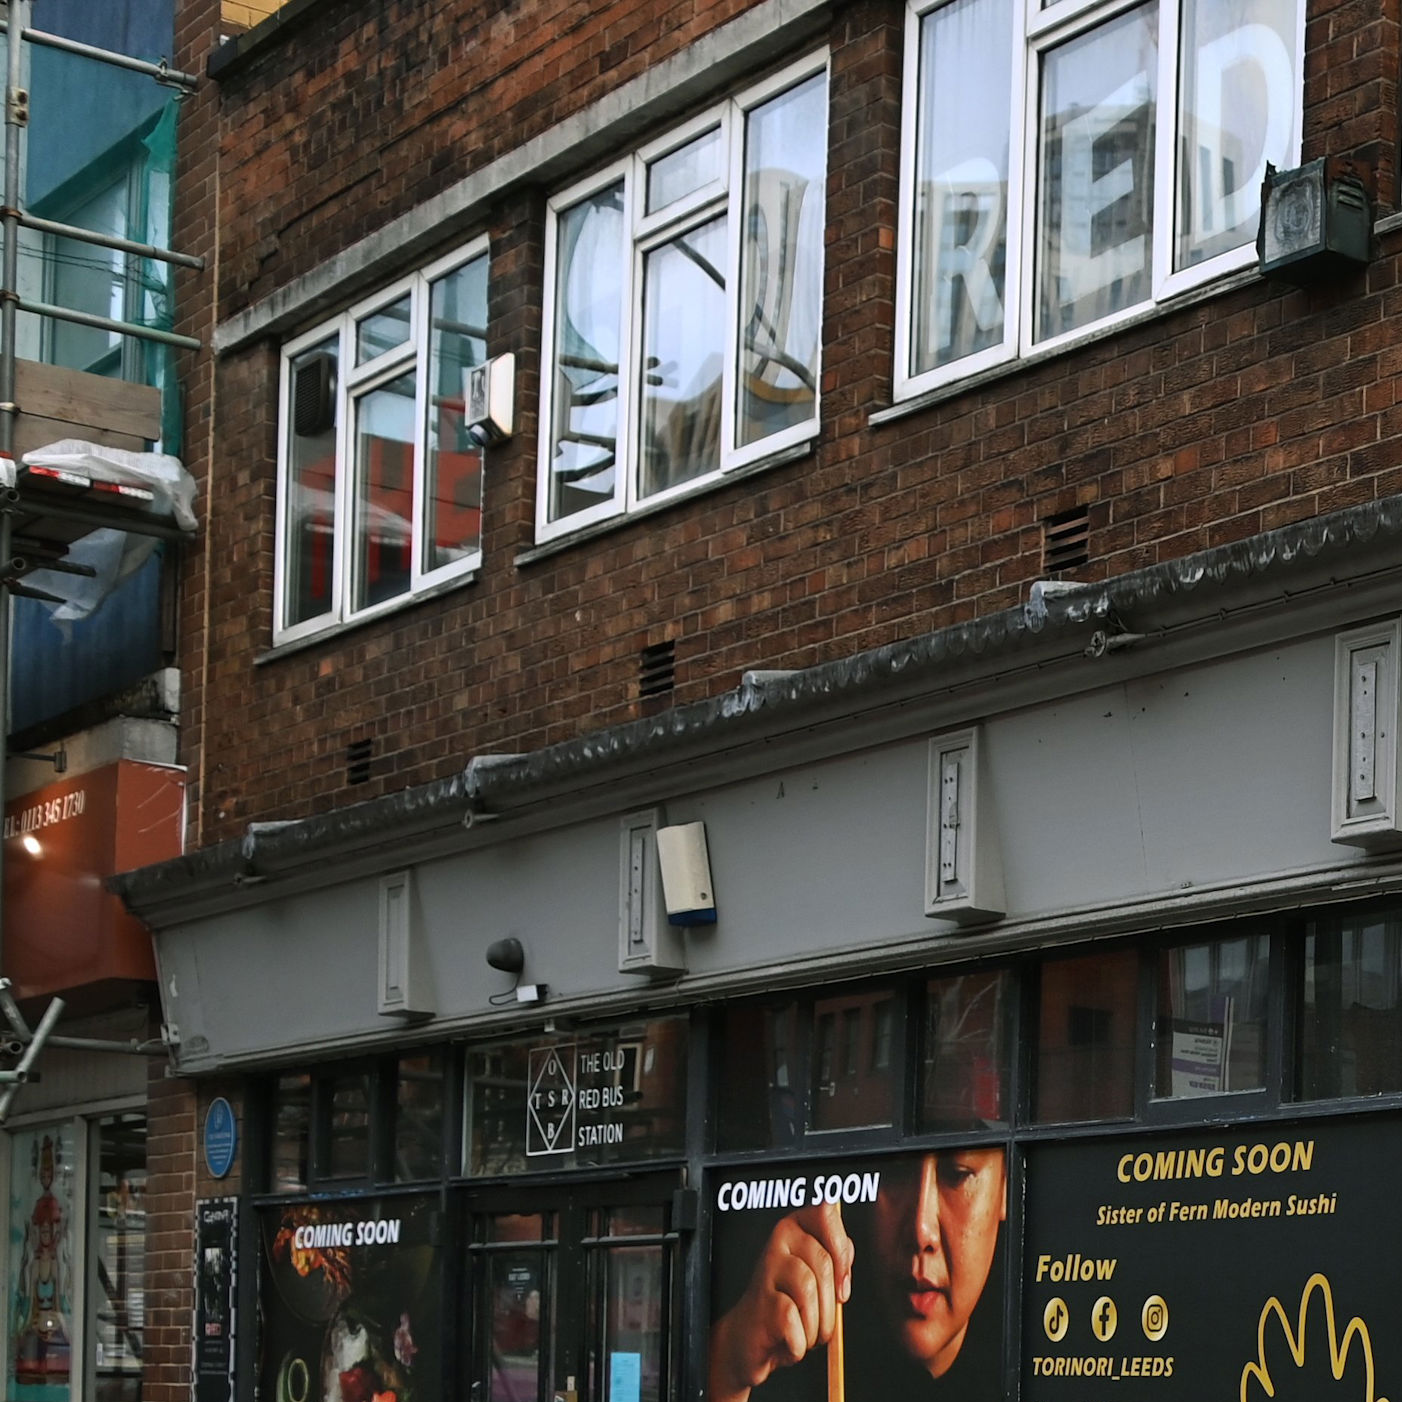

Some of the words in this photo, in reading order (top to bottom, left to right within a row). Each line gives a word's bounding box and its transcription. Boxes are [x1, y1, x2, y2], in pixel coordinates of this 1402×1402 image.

[929, 25, 1292, 353] RED
[21, 805, 42, 833] 0113
[43, 798, 62, 827] 345
[62, 790, 85, 819] 1730
[580, 1053, 601, 1074] THE
[602, 1050, 625, 1072] OLD
[579, 1089, 600, 1109] RED
[602, 1085, 624, 1107] BUS
[578, 1124, 623, 1147] STATION
[1117, 1147, 1225, 1183] COMING
[1232, 1141, 1315, 1176] SOON
[718, 1177, 806, 1212] COMING
[811, 1172, 880, 1205] SOON
[1096, 1204, 1143, 1226] Sister
[1147, 1203, 1165, 1222] of
[1169, 1201, 1208, 1222] Fern
[1212, 1198, 1281, 1219] Modern
[1286, 1193, 1337, 1216] Sushi
[295, 1222, 353, 1249] COMING
[355, 1219, 400, 1246] SOON
[1035, 1254, 1117, 1282] Follow
[1033, 1356, 1174, 1380] TORINORI_LEEDS
